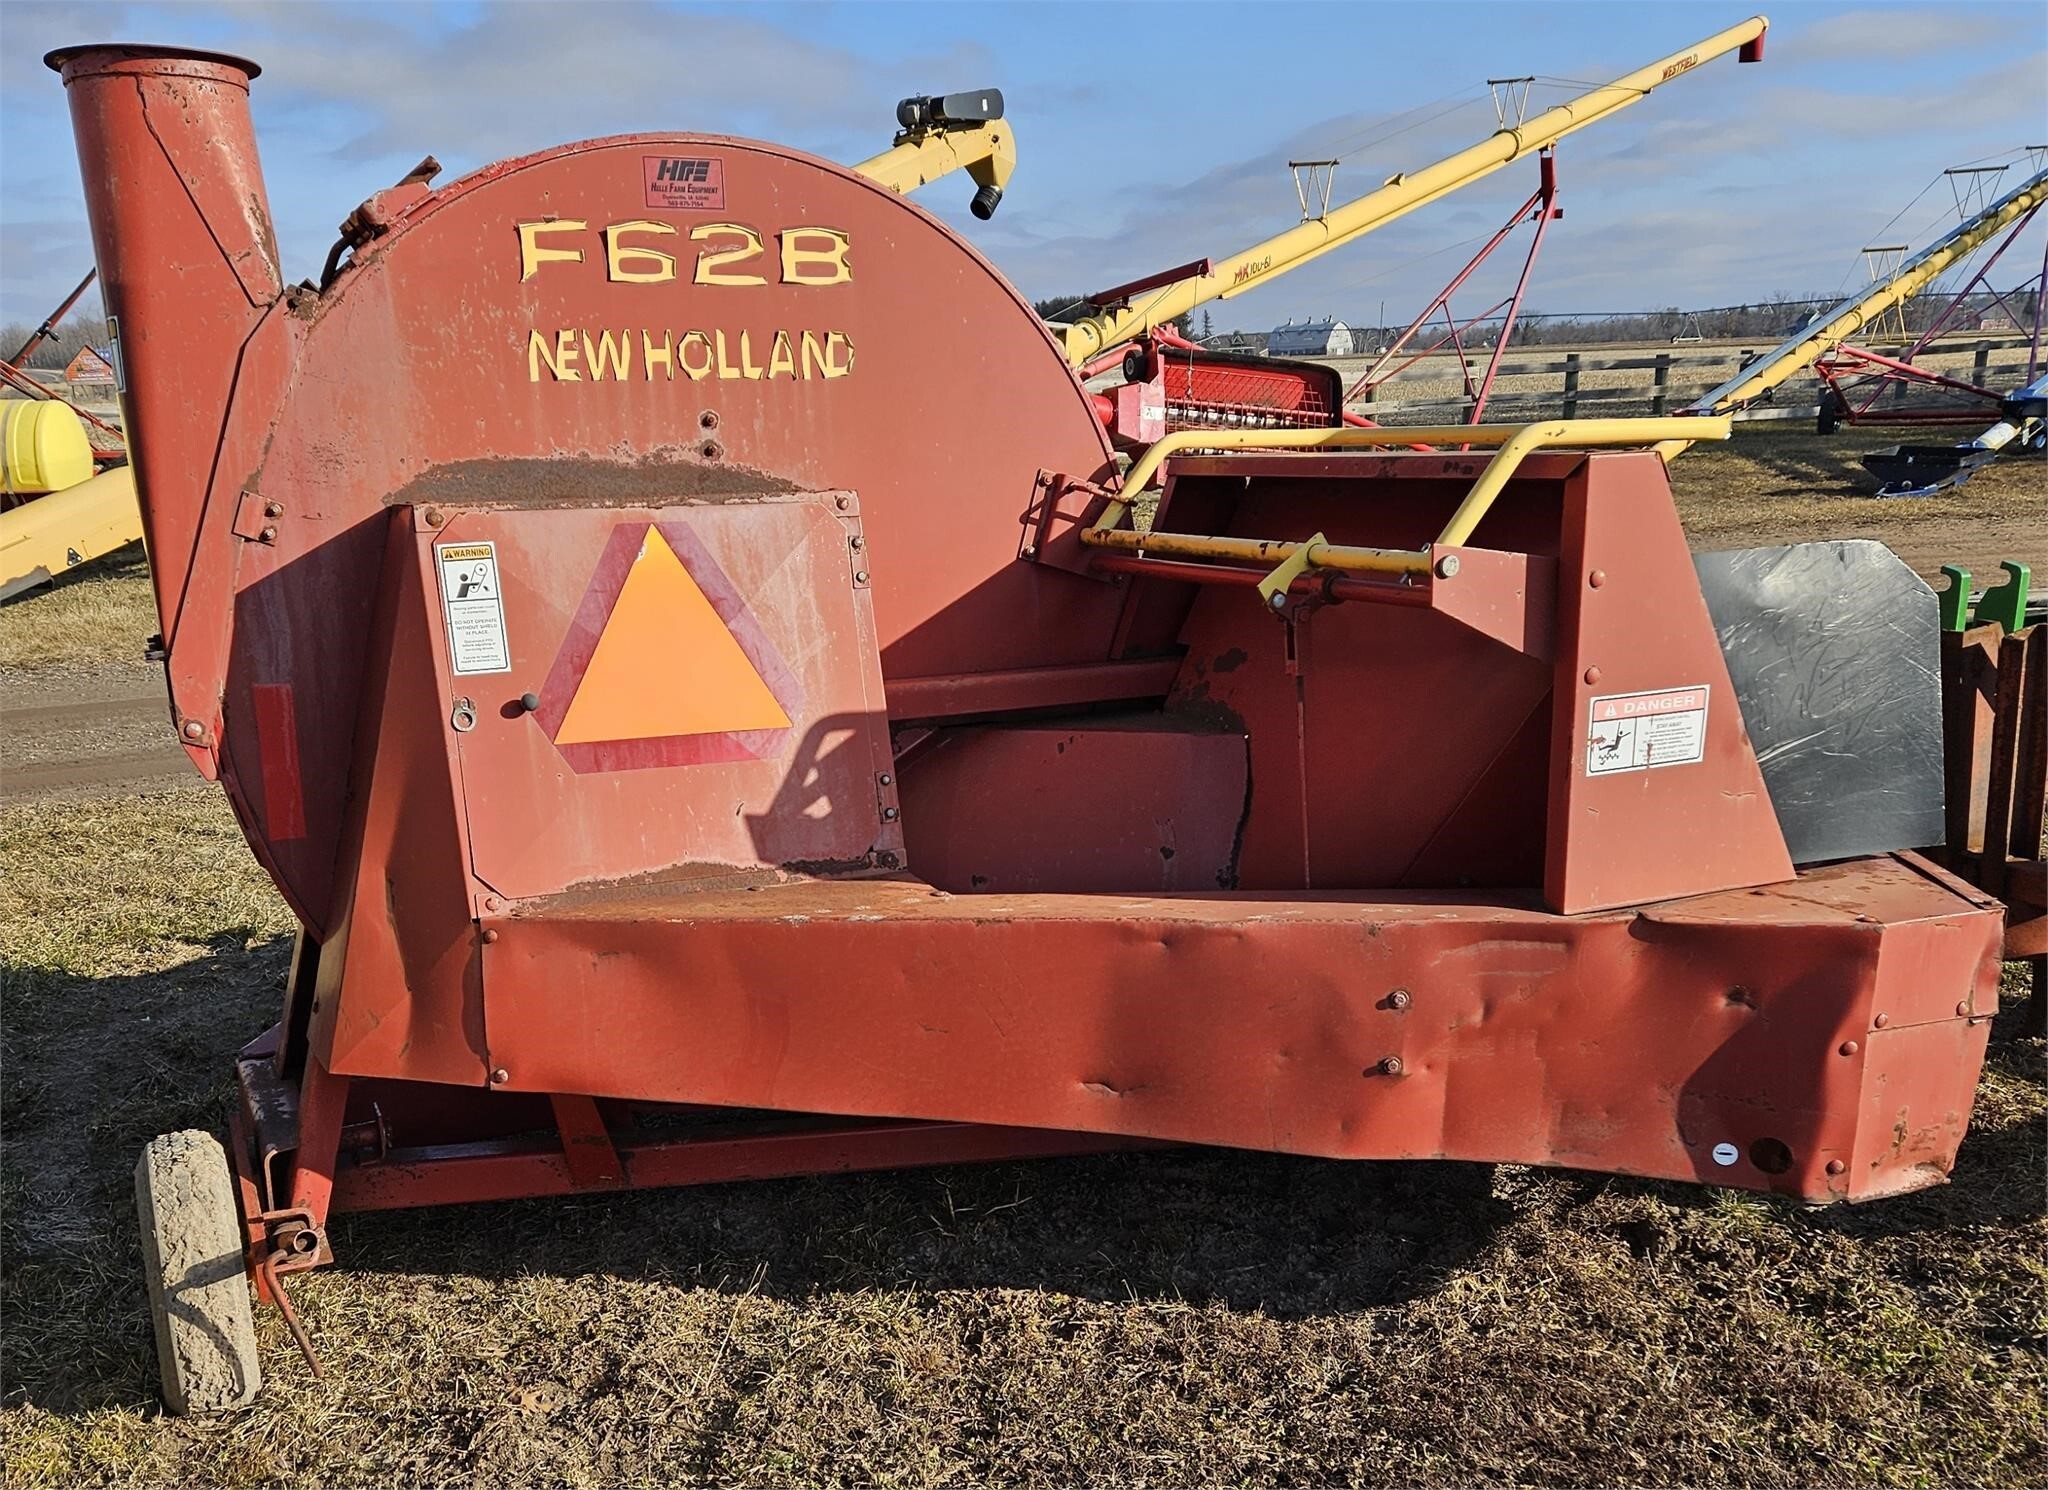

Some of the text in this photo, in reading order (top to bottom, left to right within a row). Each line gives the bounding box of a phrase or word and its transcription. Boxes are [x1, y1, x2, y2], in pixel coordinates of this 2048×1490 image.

[1661, 53, 1698, 80] WESTFIELD
[657, 159, 710, 182] HFE
[687, 183, 719, 194] EQUIPMENT
[518, 219, 853, 286] F62B
[1233, 262, 1249, 285] MK
[528, 329, 855, 382] NEW HOLLAND
[453, 548, 490, 559] WARNING
[1624, 695, 1695, 713] DANGER
